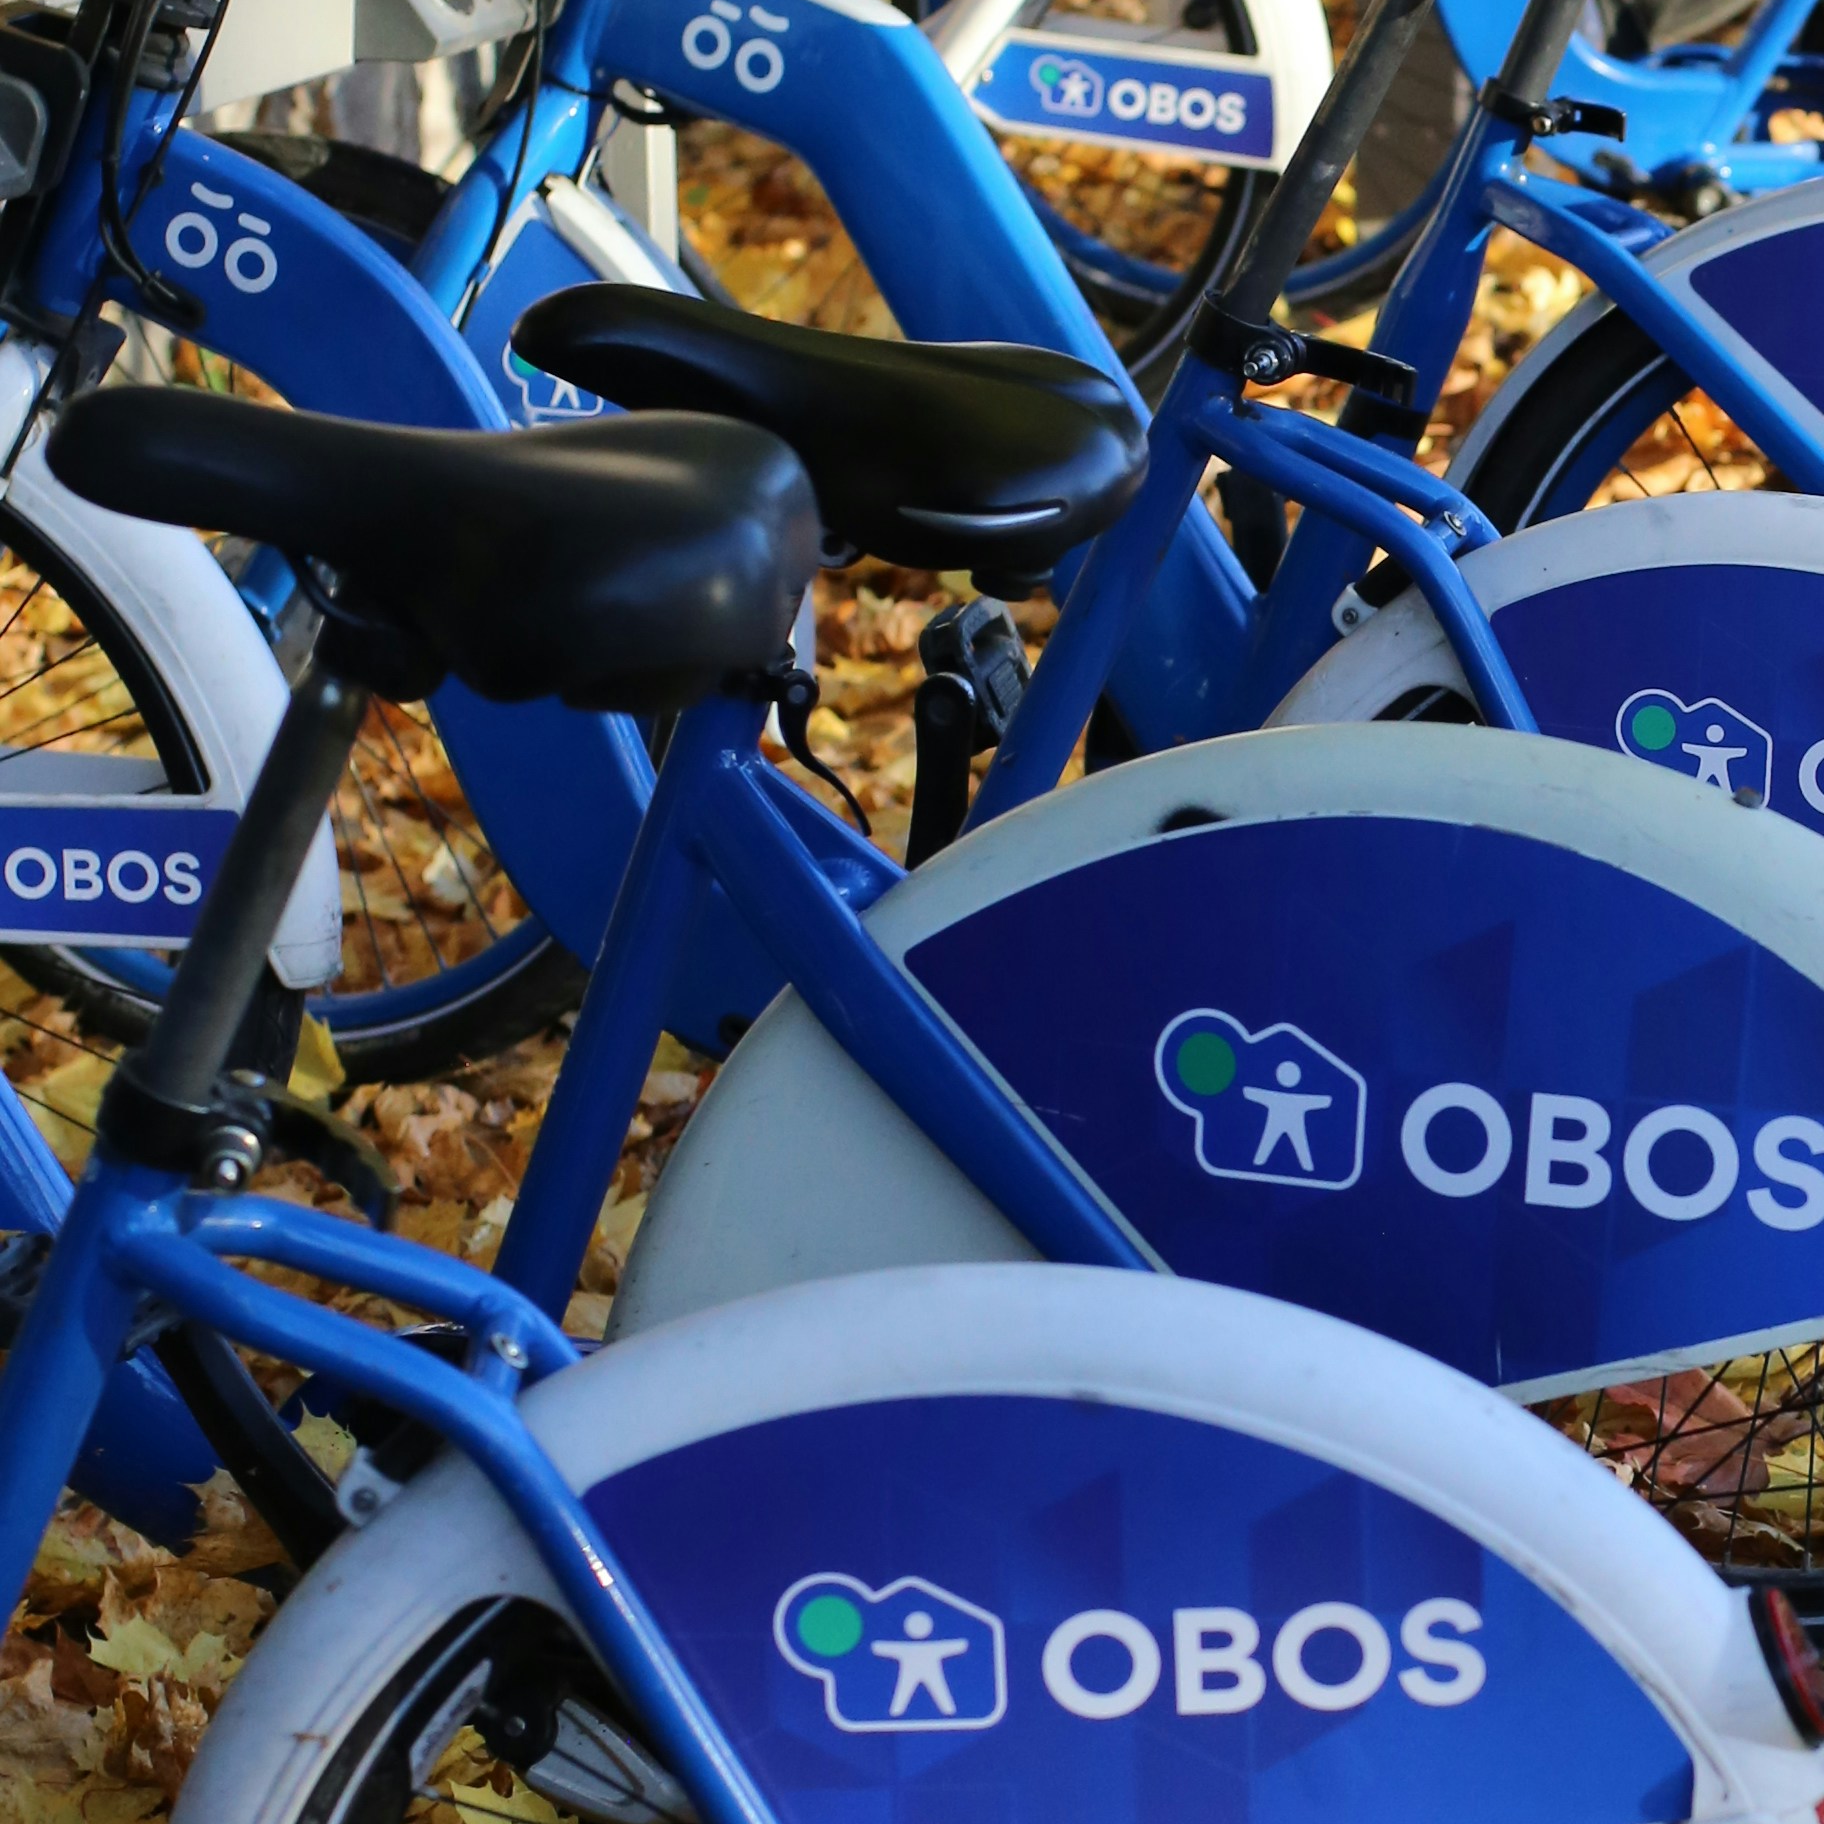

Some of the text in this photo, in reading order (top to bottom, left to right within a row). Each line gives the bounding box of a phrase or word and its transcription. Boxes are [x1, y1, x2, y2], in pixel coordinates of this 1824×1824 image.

[1108, 79, 1247, 133] OBOS
[4, 846, 203, 905] OBOS
[1041, 1598, 1488, 1721] OBOS
